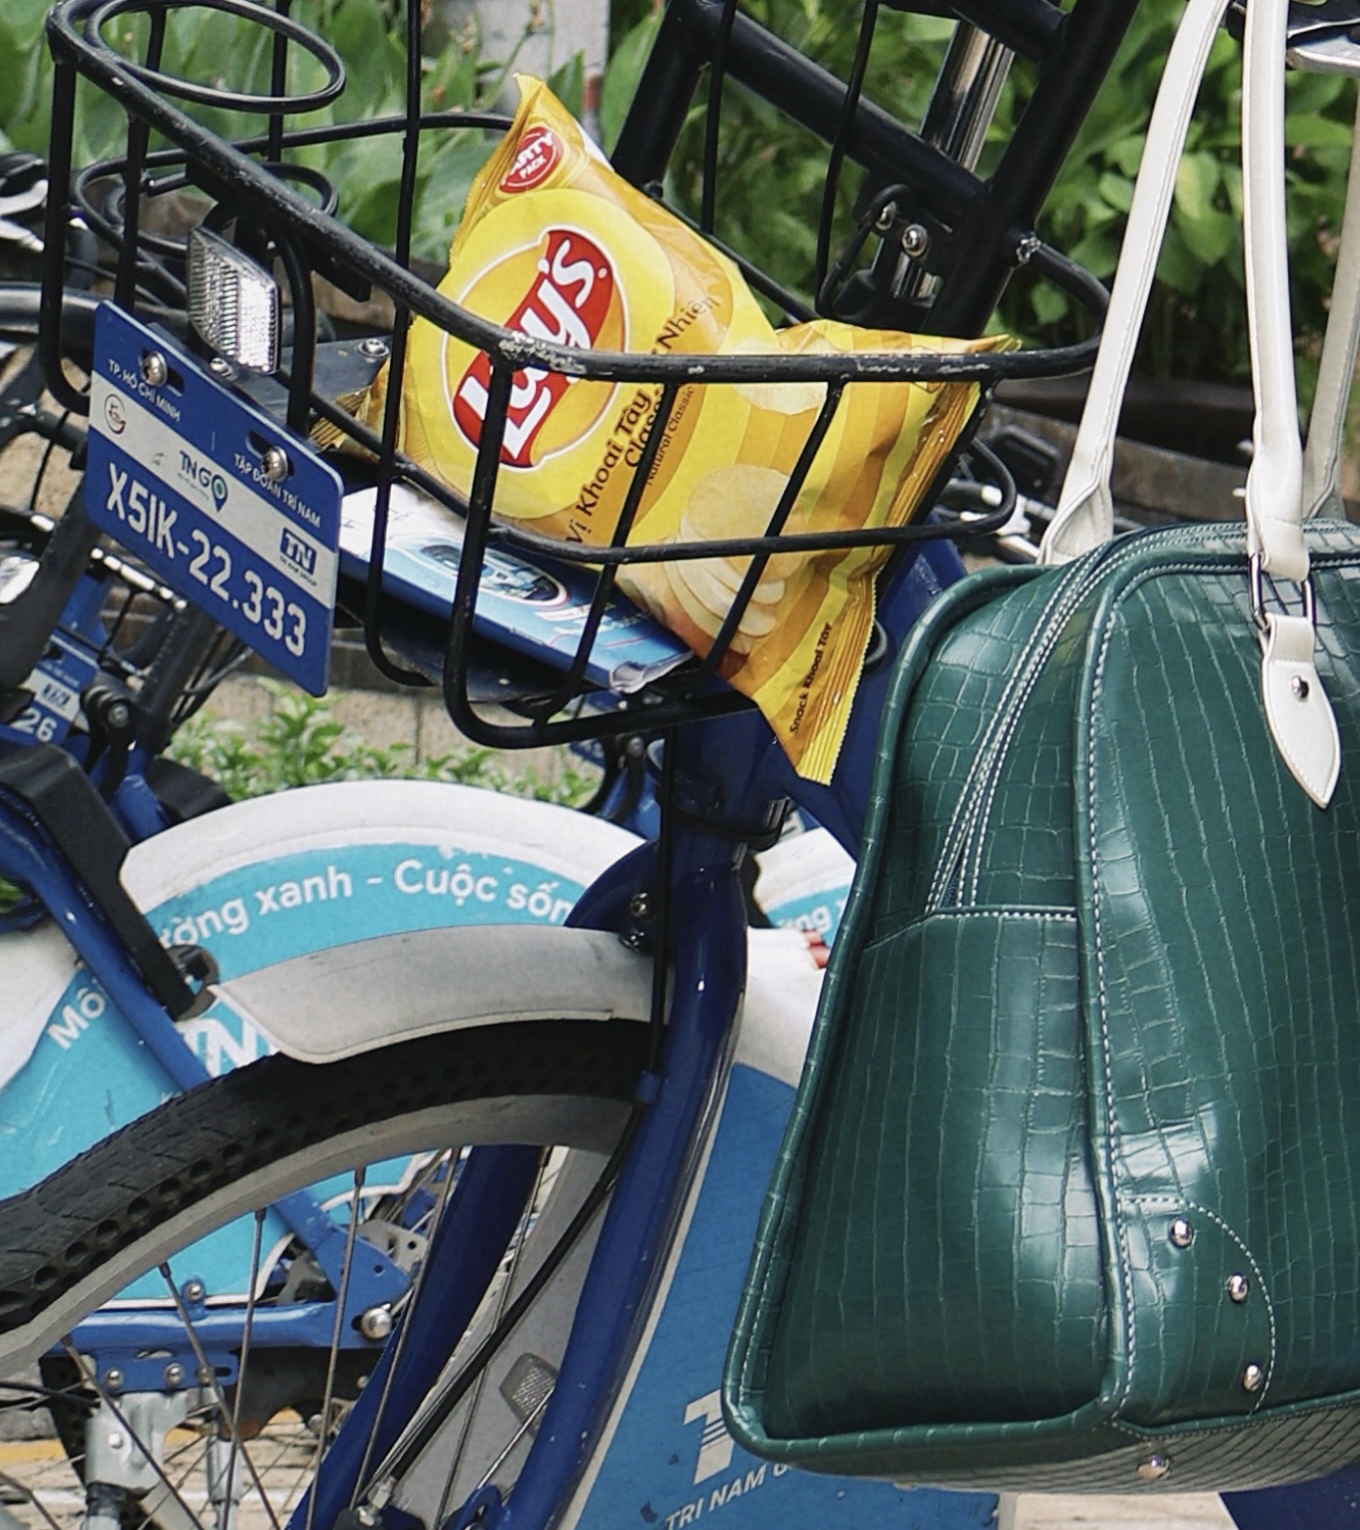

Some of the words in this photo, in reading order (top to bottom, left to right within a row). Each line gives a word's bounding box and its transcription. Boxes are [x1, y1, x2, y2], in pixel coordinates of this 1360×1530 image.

[510, 132, 553, 177] ARTY
[519, 155, 547, 180] PACK
[669, 385, 695, 431] Classic
[577, 438, 623, 518] Khoai
[614, 388, 652, 438] Tây
[790, 692, 808, 734] Snack
[253, 864, 353, 917] xanh
[393, 857, 499, 907] Cuộc
[505, 879, 574, 924] sốn
[48, 977, 106, 1051] Mô
[709, 1462, 769, 1513] NAM
